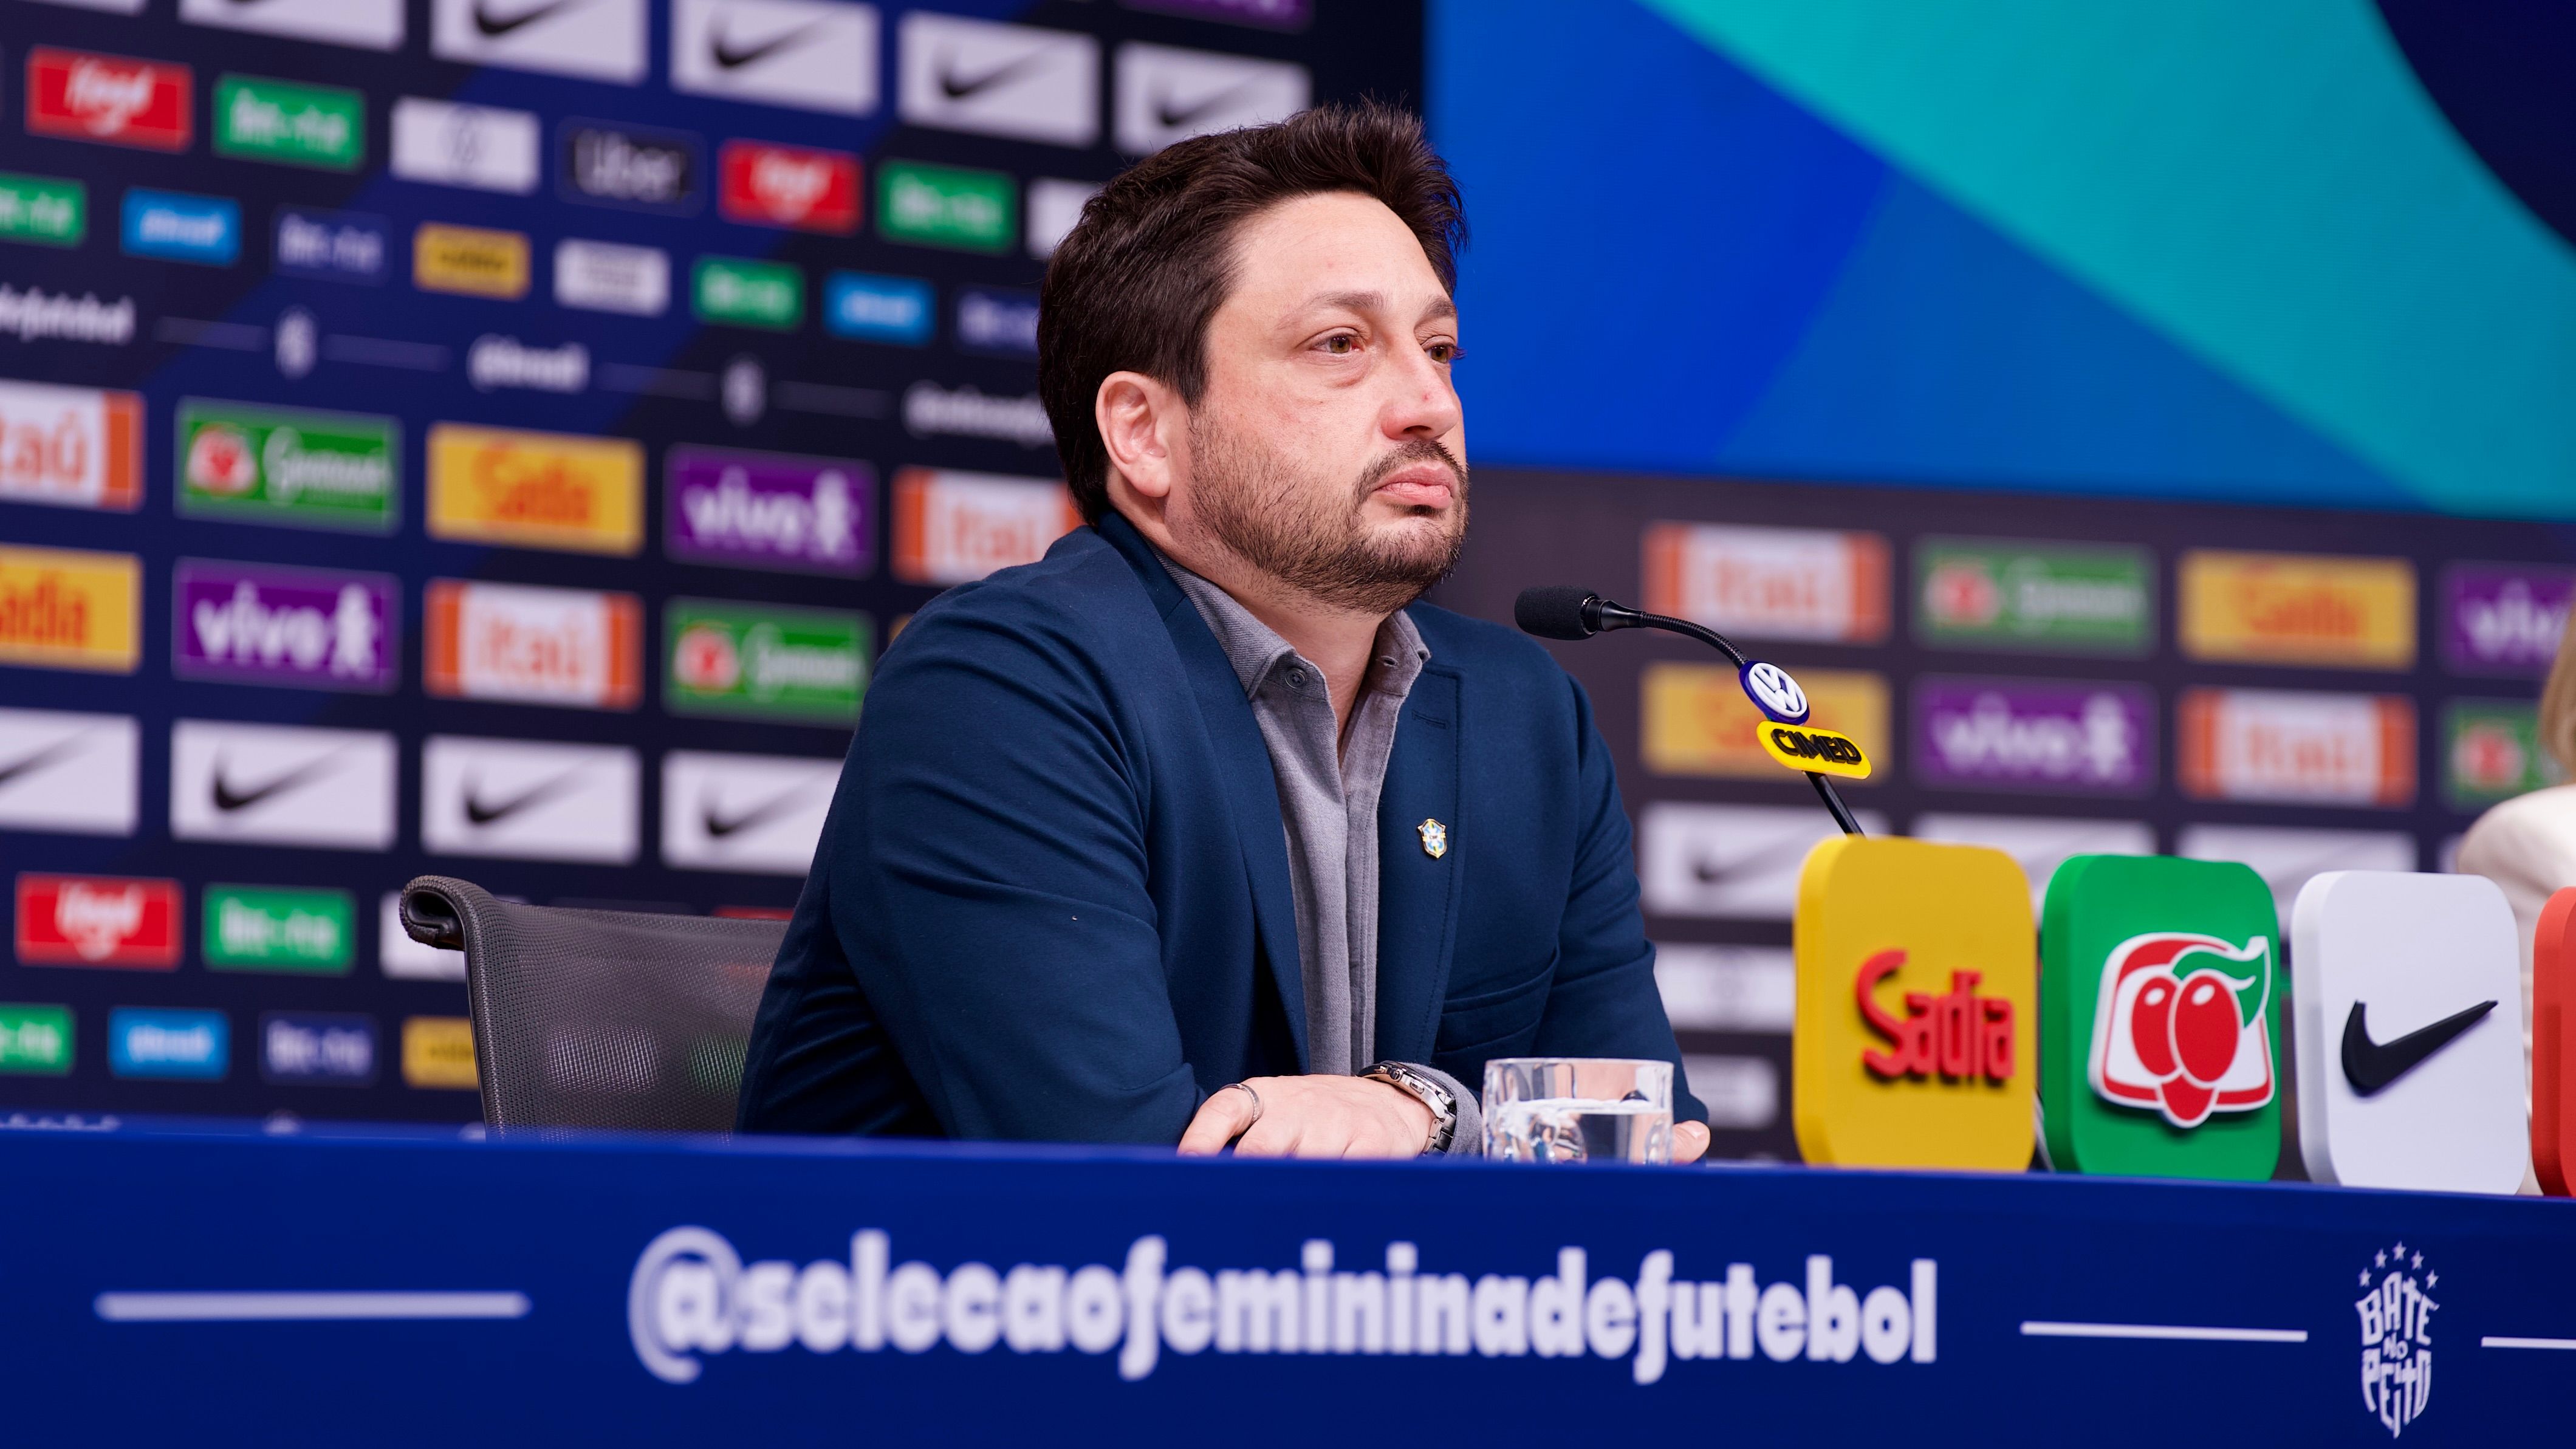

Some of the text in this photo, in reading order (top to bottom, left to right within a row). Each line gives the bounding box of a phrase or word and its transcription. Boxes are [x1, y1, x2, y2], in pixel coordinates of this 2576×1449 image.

[682, 467, 811, 555] vivo
[193, 581, 329, 671] vivo
[1771, 728, 1862, 765] CIMED
[1855, 948, 2016, 1079] Sadia
[628, 1225, 1937, 1385] @selecaofemininadefutebol
[2355, 1271, 2439, 1346] BATE
